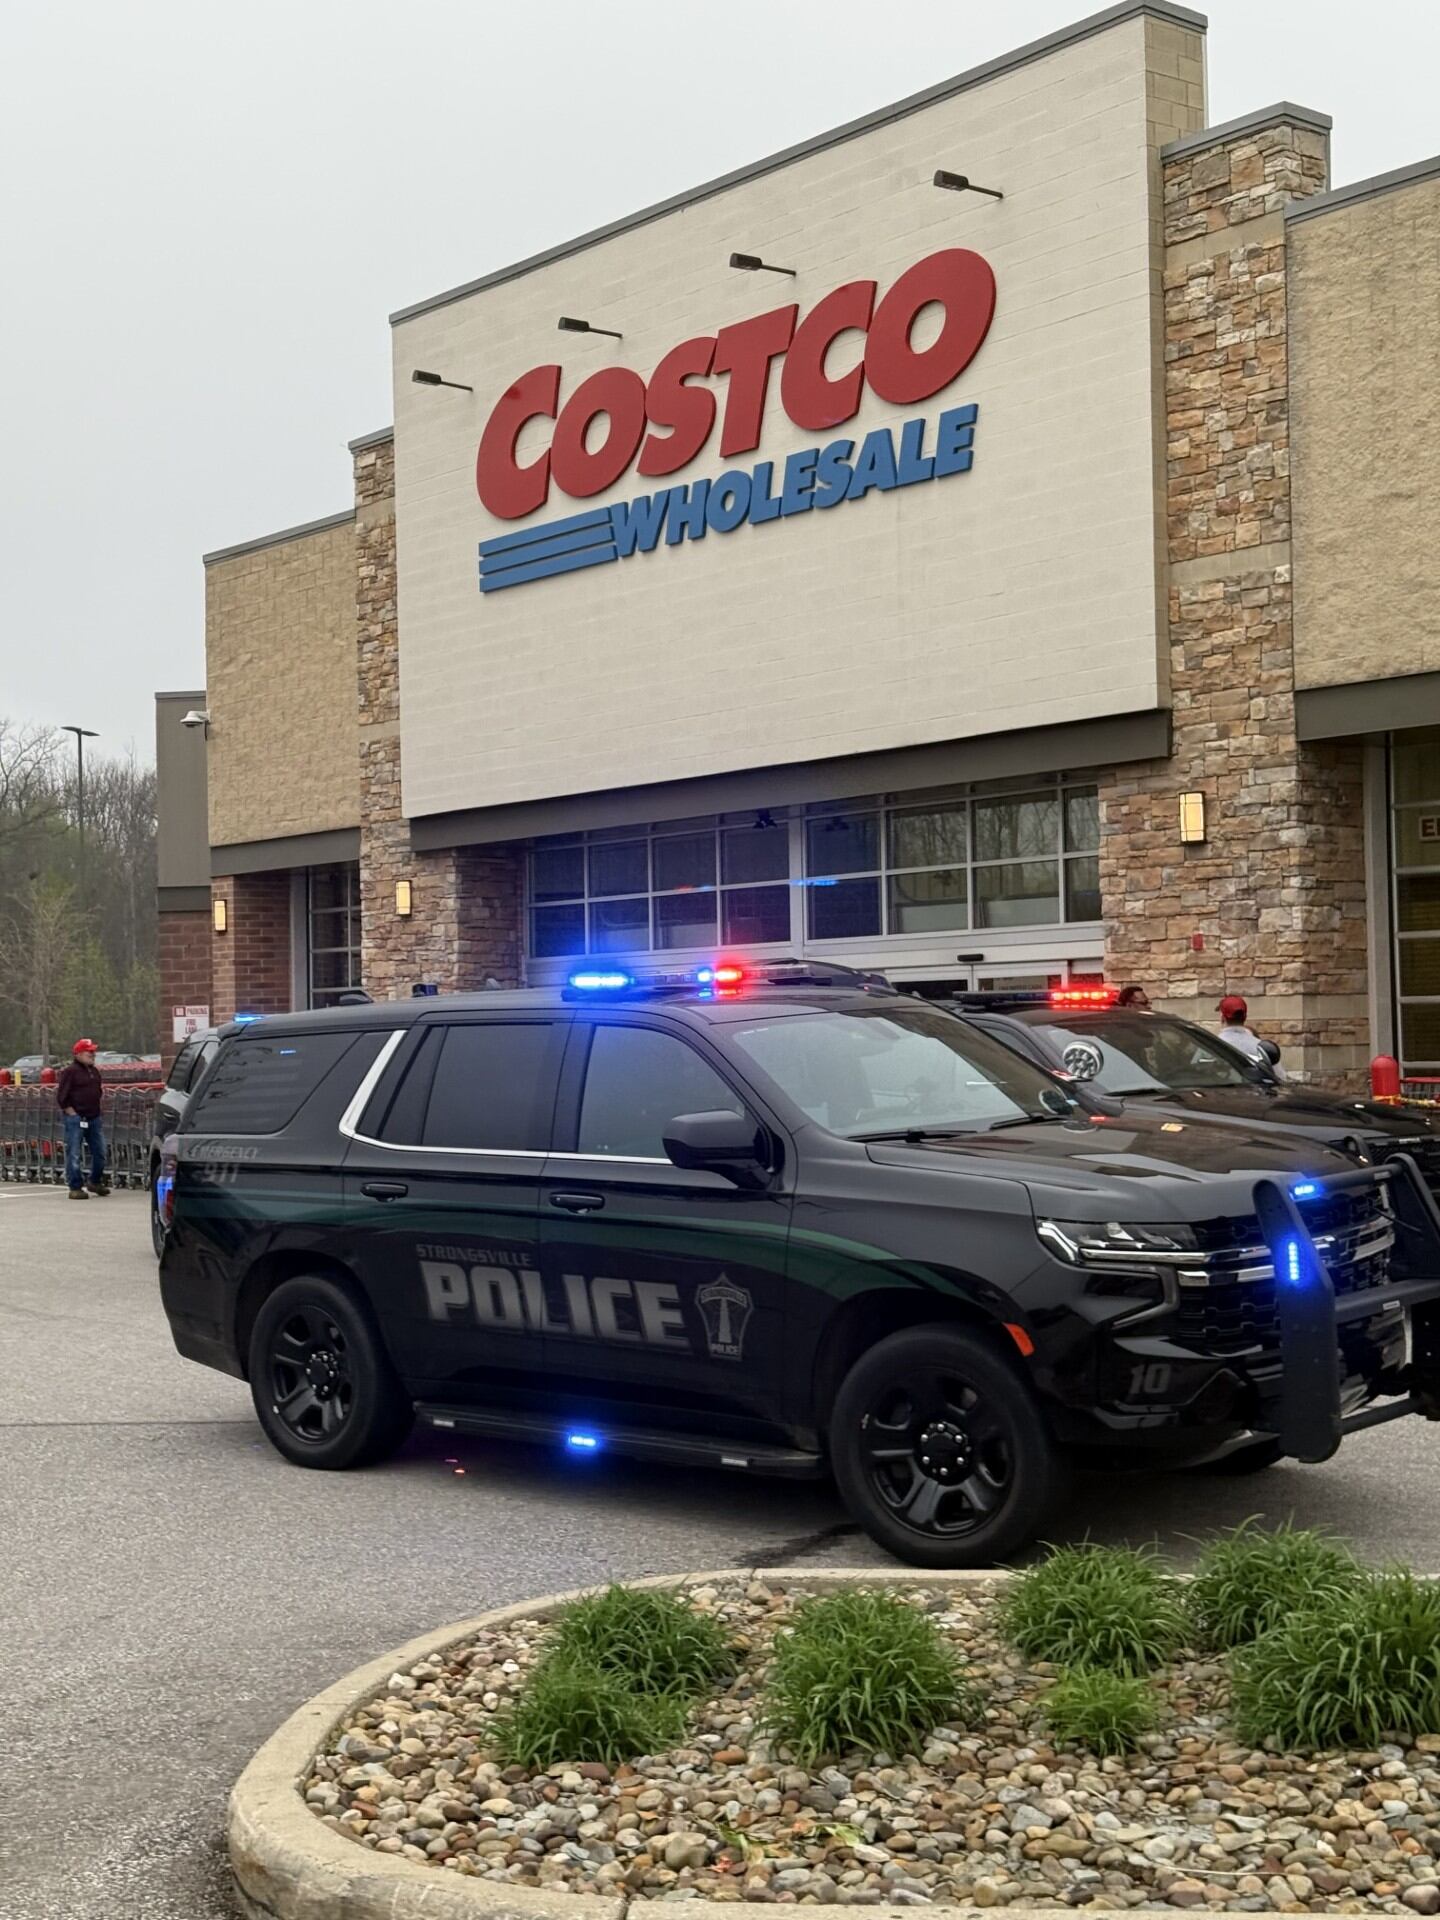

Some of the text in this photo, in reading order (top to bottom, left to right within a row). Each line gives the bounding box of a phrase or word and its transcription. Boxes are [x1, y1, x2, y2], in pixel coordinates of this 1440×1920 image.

[476, 248, 996, 519] COSTCO
[610, 403, 979, 557] WHOLESALE
[201, 1162, 240, 1184] 911
[415, 1243, 531, 1267] STRONGSVILLE
[419, 1260, 692, 1351] POLICE
[1129, 1363, 1172, 1394] 10
